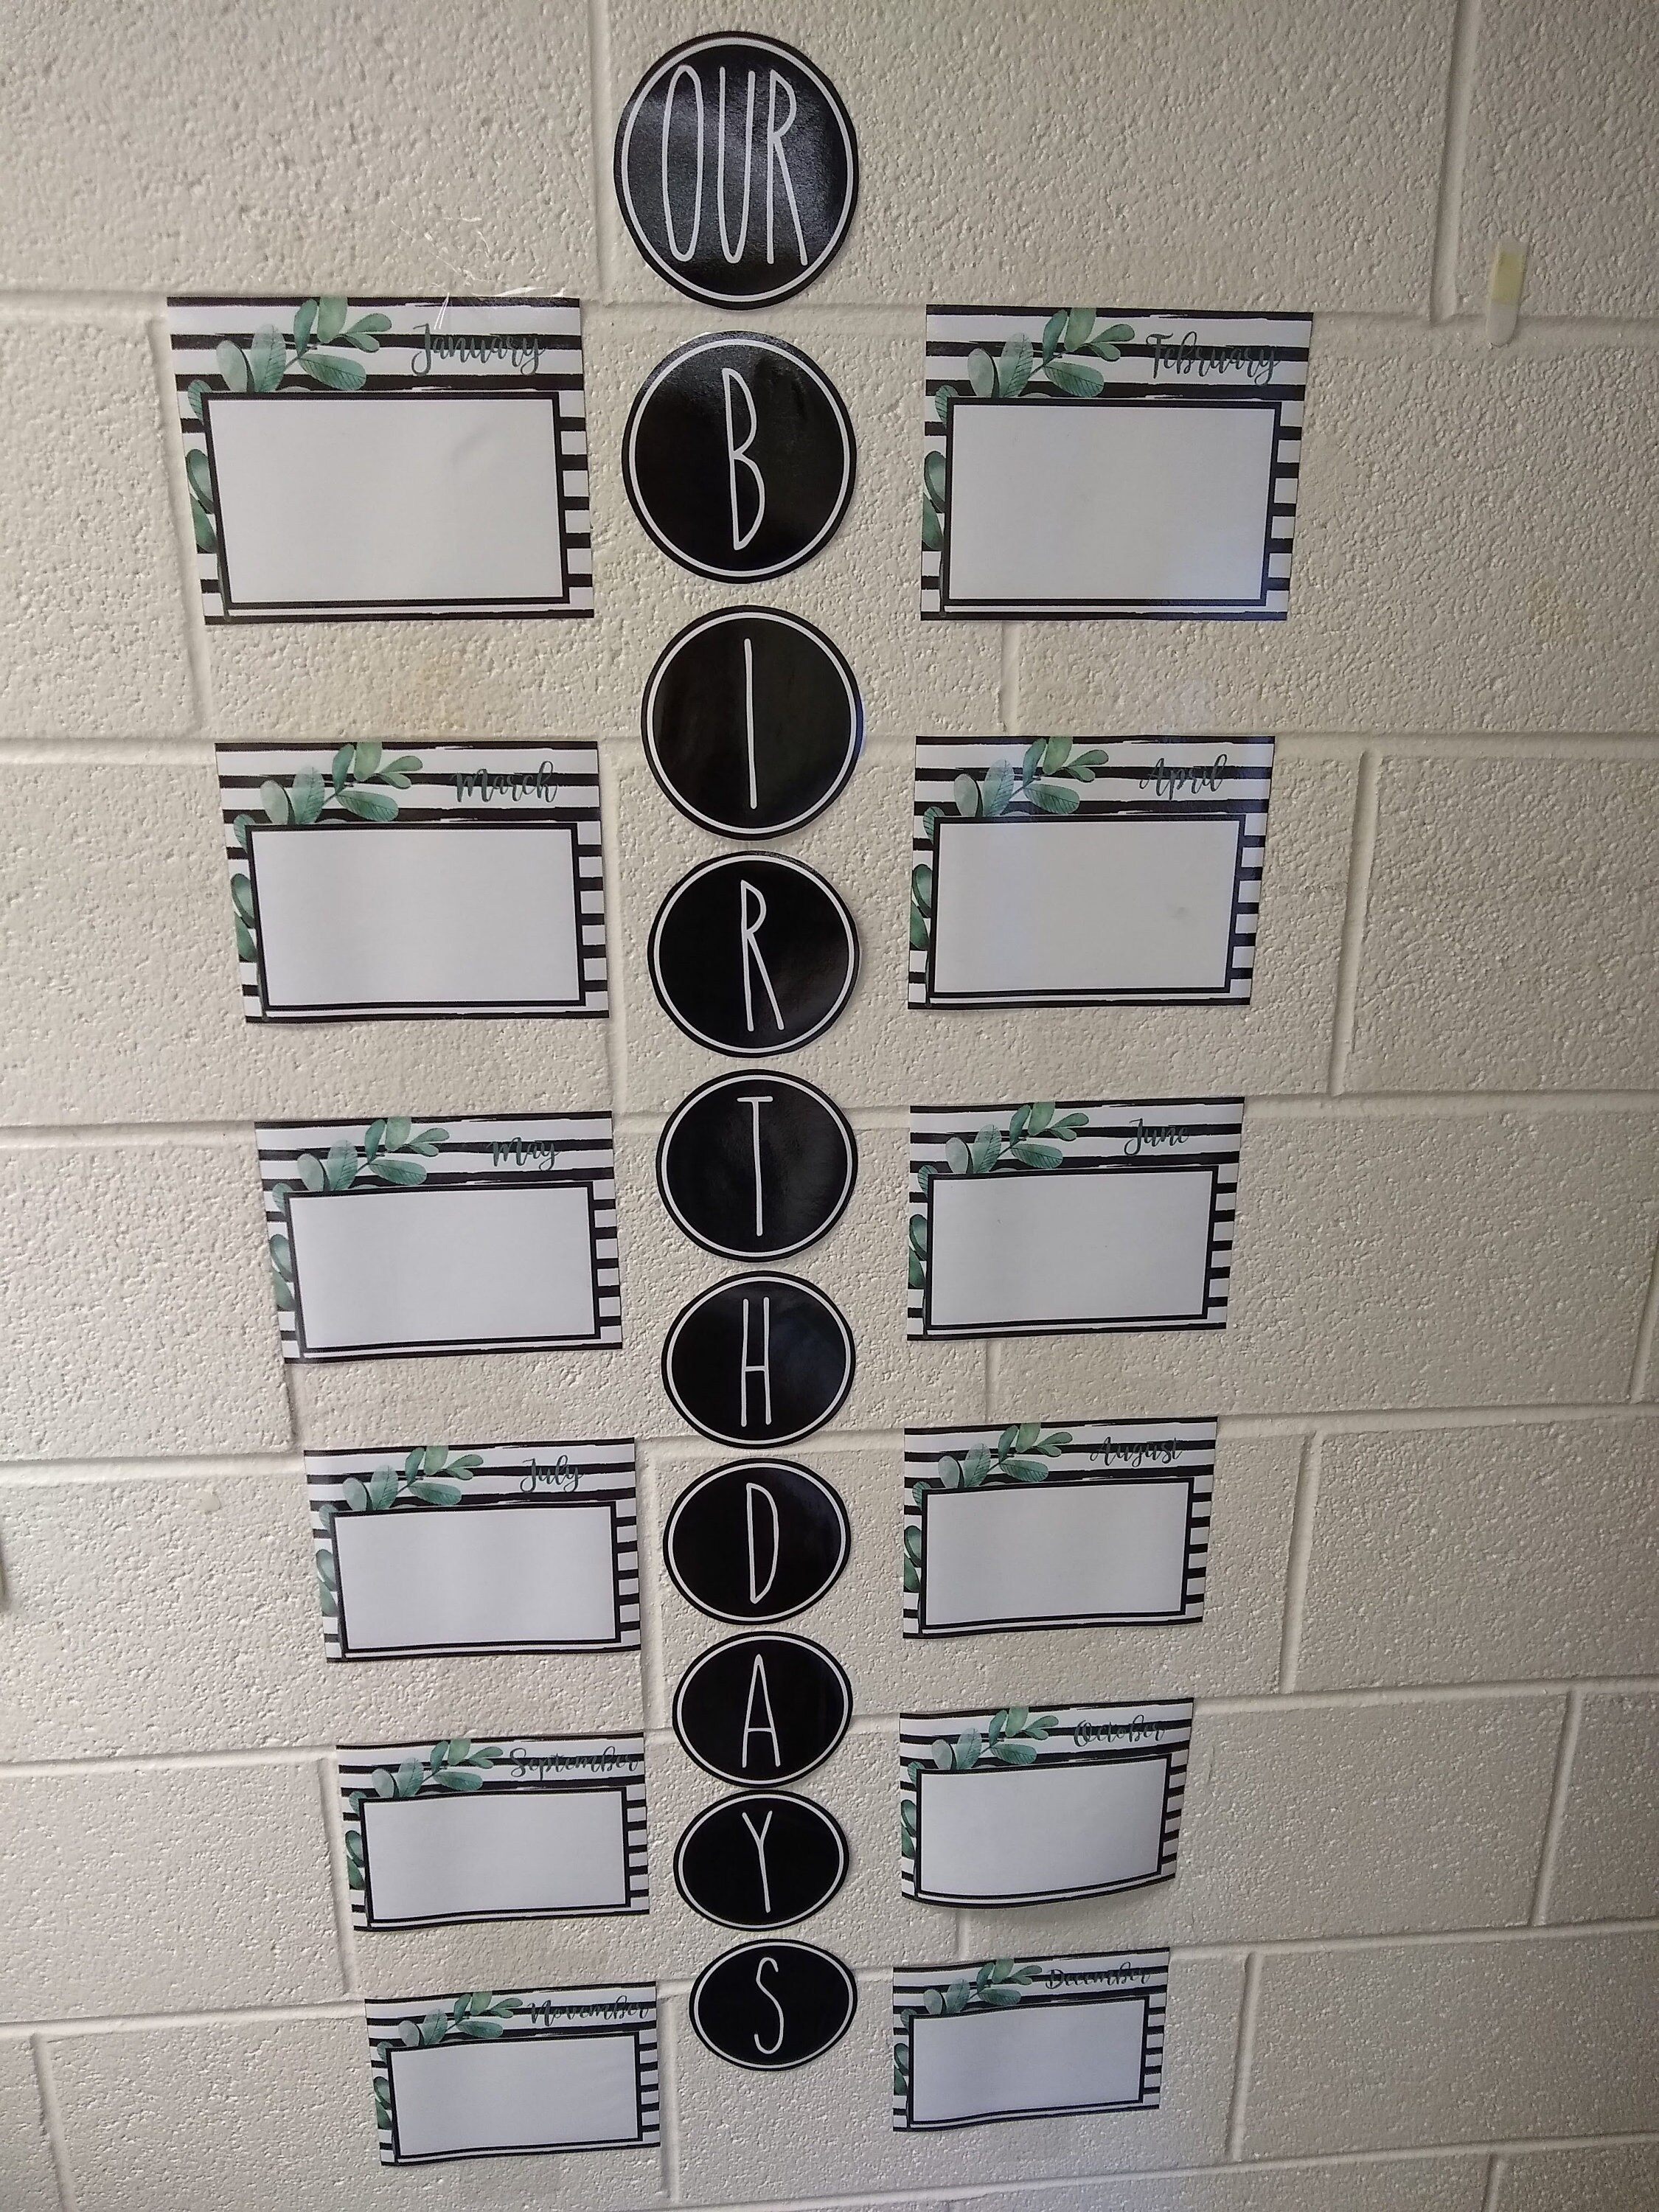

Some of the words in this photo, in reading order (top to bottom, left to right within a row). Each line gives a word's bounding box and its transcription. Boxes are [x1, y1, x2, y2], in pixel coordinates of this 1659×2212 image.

[663, 64, 807, 266] OUR
[411, 322, 544, 377] January
[1145, 331, 1281, 386] February
[449, 760, 558, 803] March
[1139, 754, 1228, 801] April
[486, 1136, 561, 1171] May
[1124, 1118, 1190, 1156] June
[1089, 1436, 1183, 1467] August
[520, 1455, 585, 1494] July
[1074, 1714, 1165, 1747] October
[509, 1745, 639, 1781] September
[1045, 1961, 1151, 1989] December
[526, 1994, 649, 2027] November
